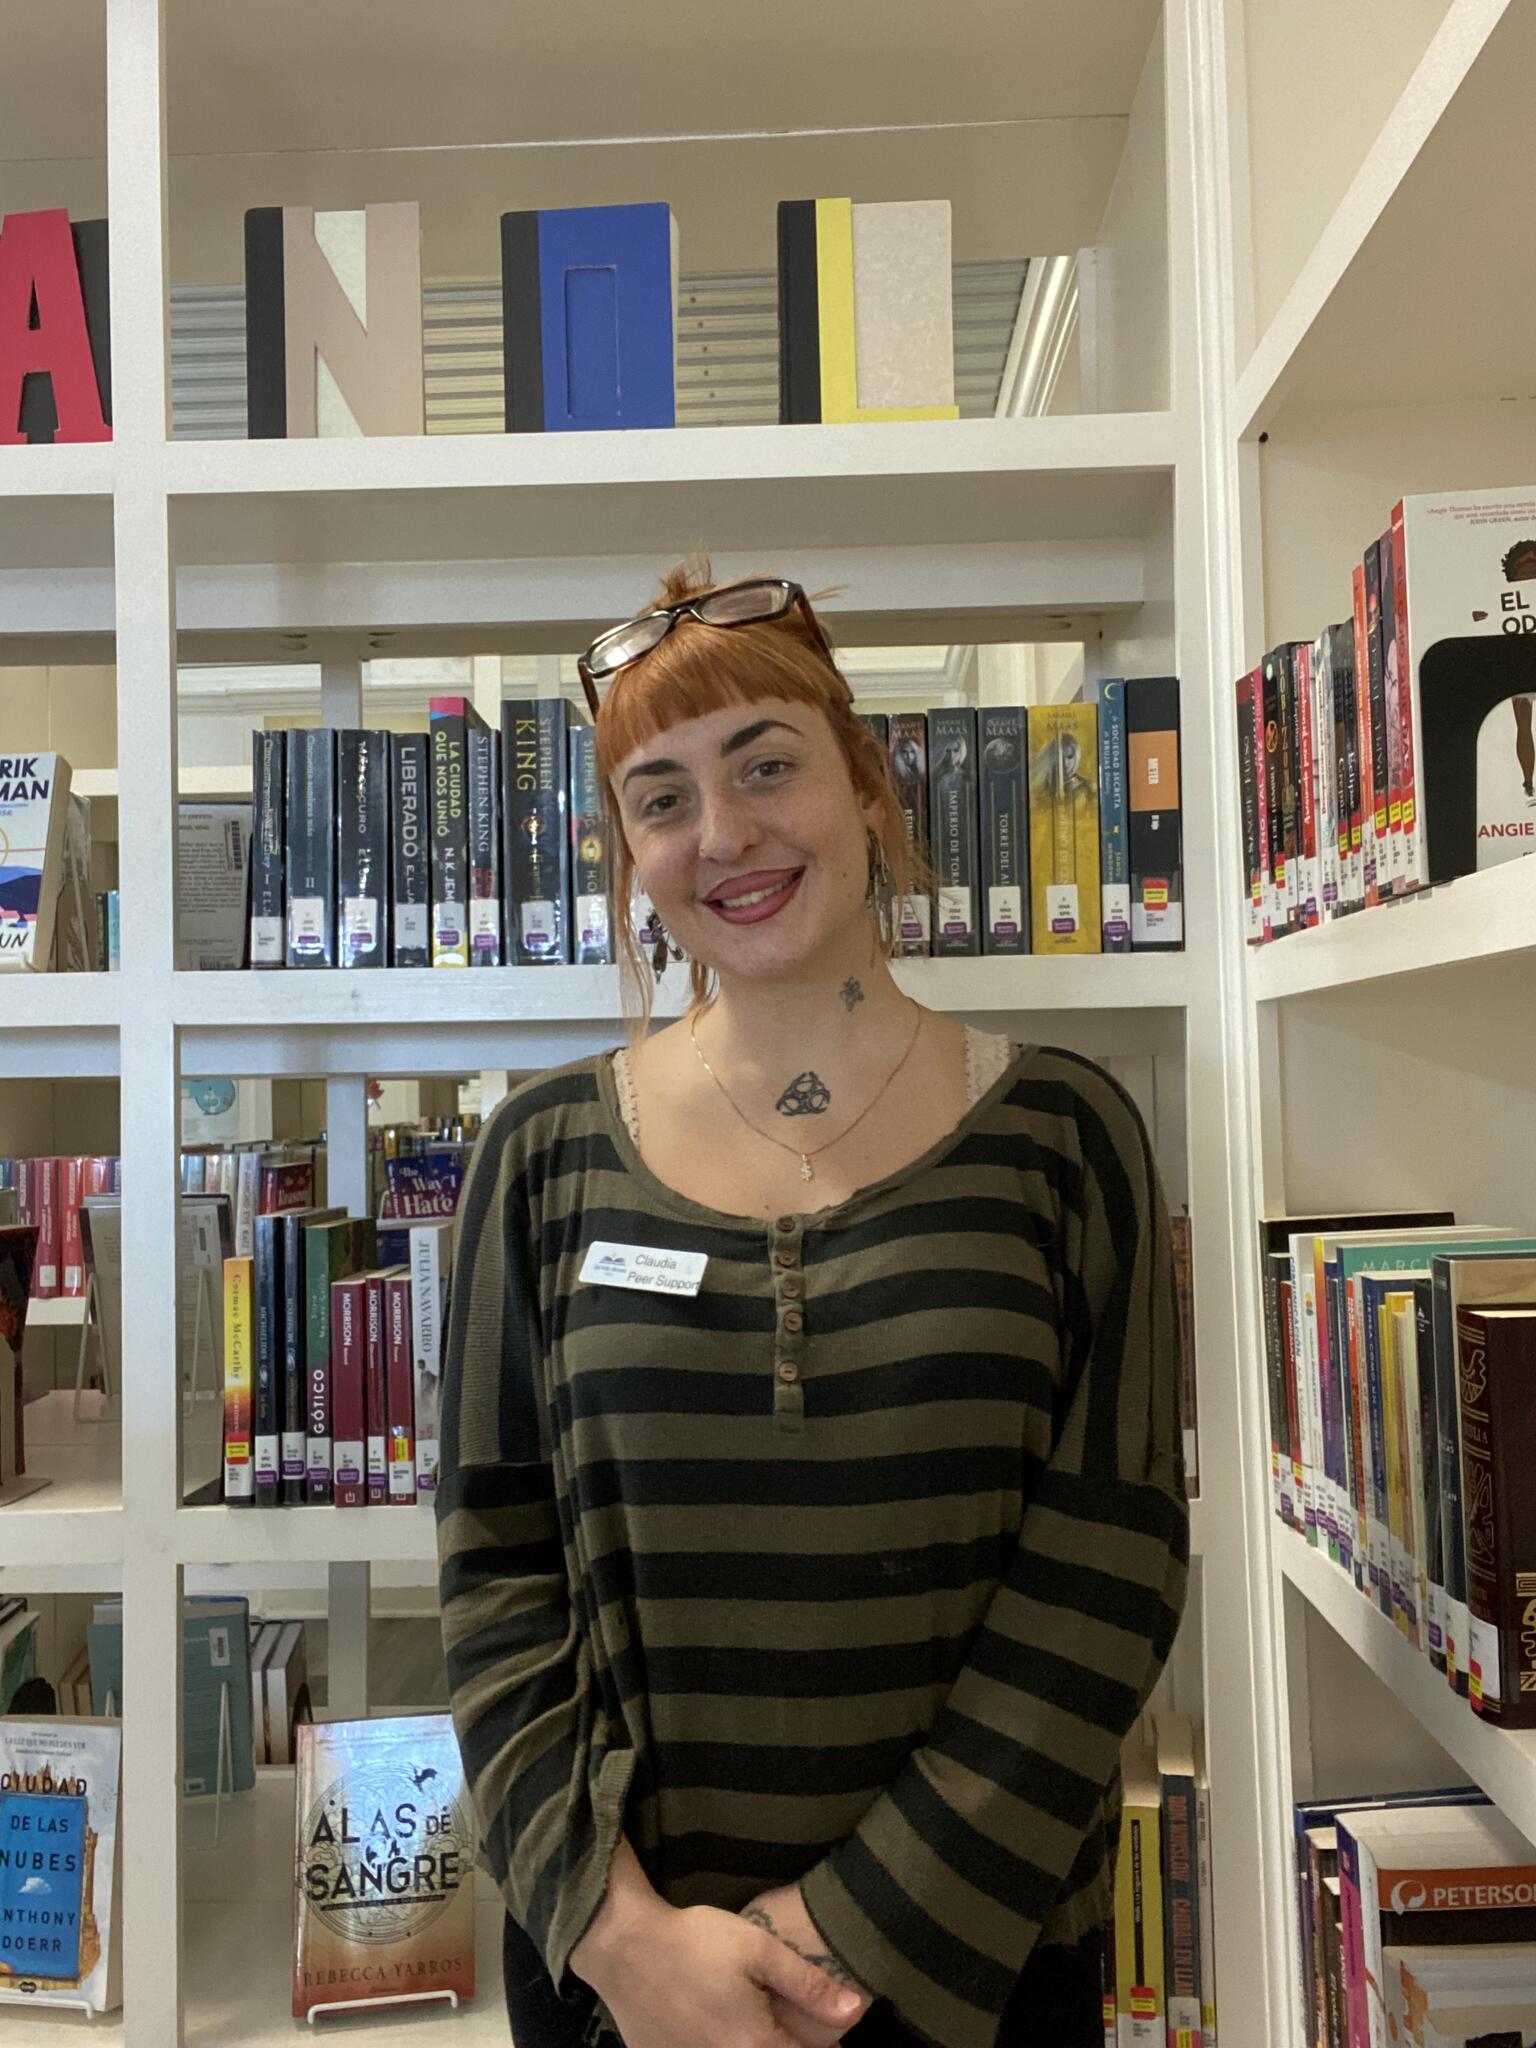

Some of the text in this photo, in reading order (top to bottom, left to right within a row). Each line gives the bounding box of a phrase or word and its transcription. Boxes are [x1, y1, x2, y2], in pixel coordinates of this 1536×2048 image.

[1500, 590, 1529, 612] EL
[935, 726, 968, 737] MAAS
[985, 726, 1019, 738] MAAS
[1111, 724, 1121, 769] SOCIEDAD
[0, 757, 39, 779] RIK
[478, 735, 491, 805] STEPHEN
[515, 718, 537, 791] KING
[540, 716, 552, 791] STEPHEN
[435, 731, 451, 838] QUE NOS UNIÓ
[449, 741, 462, 818] LA CIUDAD
[1113, 771, 1122, 809] SECRETA
[478, 809, 491, 854] KING
[948, 790, 960, 837] IMPERIO
[998, 812, 1009, 848] TORRE
[1478, 822, 1535, 839] ANGIE
[949, 840, 960, 855] DE
[999, 850, 1010, 872] DEL
[402, 1191, 454, 1217] Hate
[625, 1270, 655, 1285] Peer
[634, 1253, 678, 1271] Claudia
[419, 1239, 434, 1351] JULIA NAVARRO
[229, 1273, 243, 1380] Cormac McCarthy
[342, 1292, 353, 1345] MORRISON
[369, 1289, 379, 1342] MORRISON
[392, 1290, 403, 1344] MORRISON
[311, 1368, 326, 1435] GÓTICO
[10, 1814, 69, 1835] DE LAS
[310, 1803, 453, 1847] ALAS DE
[0, 1848, 76, 1873] NUBES
[305, 1851, 461, 1903] SANGRE
[1432, 1884, 1536, 1908] PETERSO
[4, 1908, 76, 1927] NTHONY
[2, 1935, 62, 1954] DOERR
[303, 1955, 464, 1987] REBECCA YARROS
